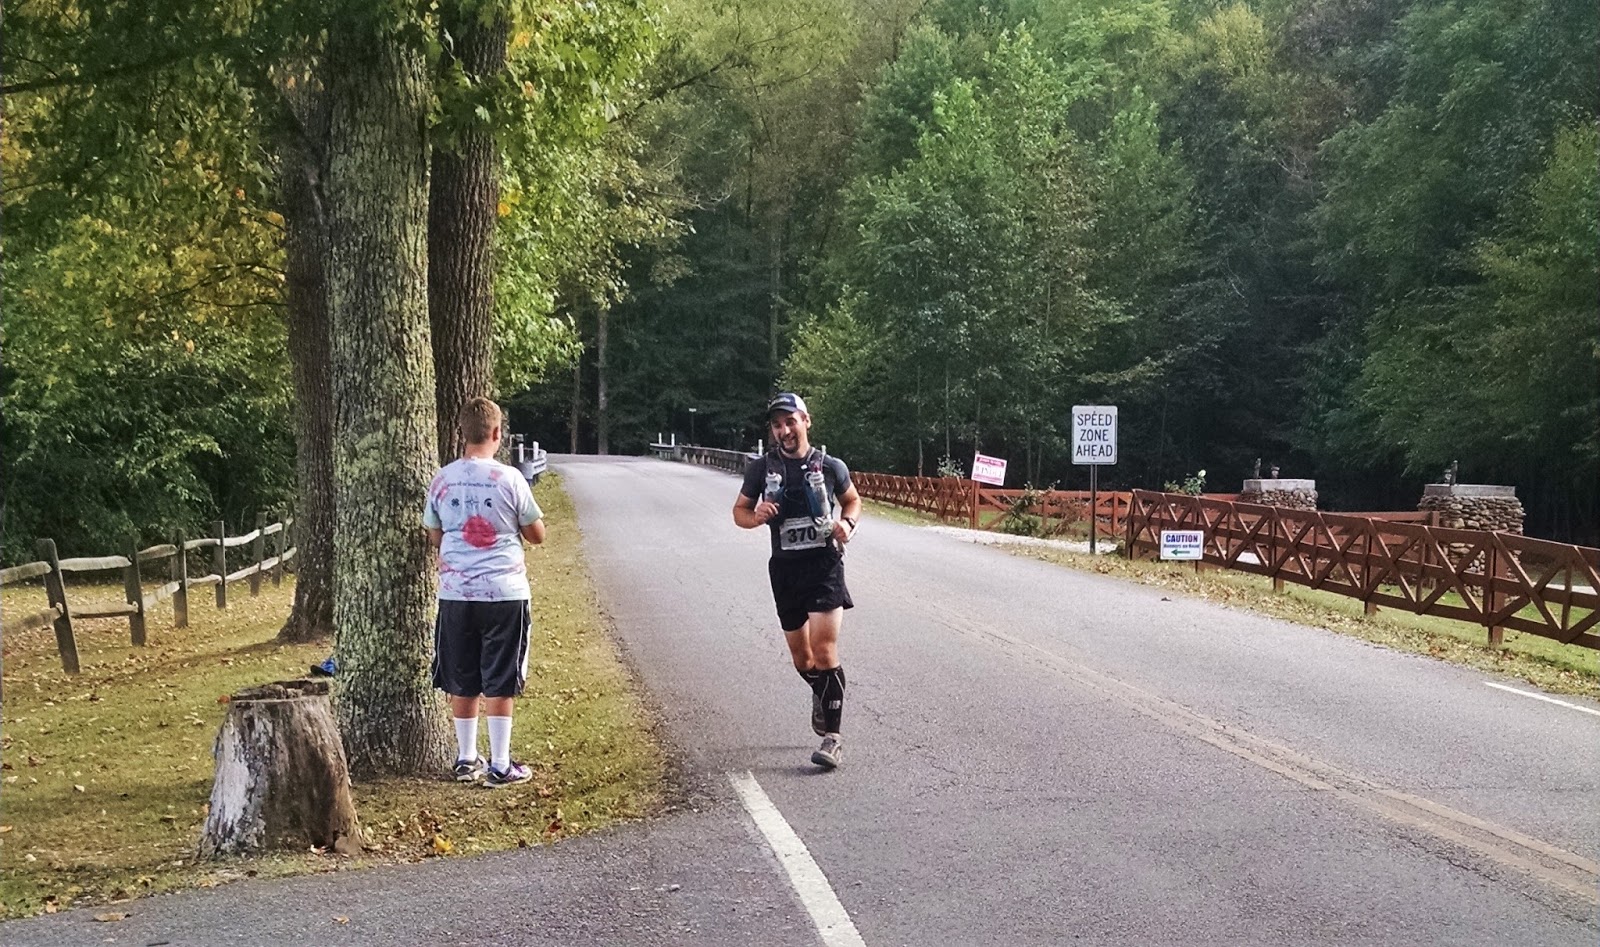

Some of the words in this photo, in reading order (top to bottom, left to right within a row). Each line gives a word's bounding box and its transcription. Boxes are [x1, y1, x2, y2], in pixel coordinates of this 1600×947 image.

[1077, 413, 1113, 427] SPEED
[1080, 428, 1109, 442] ZONE
[1076, 444, 1113, 457] AHEAD
[787, 526, 818, 543] 370
[1165, 534, 1198, 543] CAUTION
